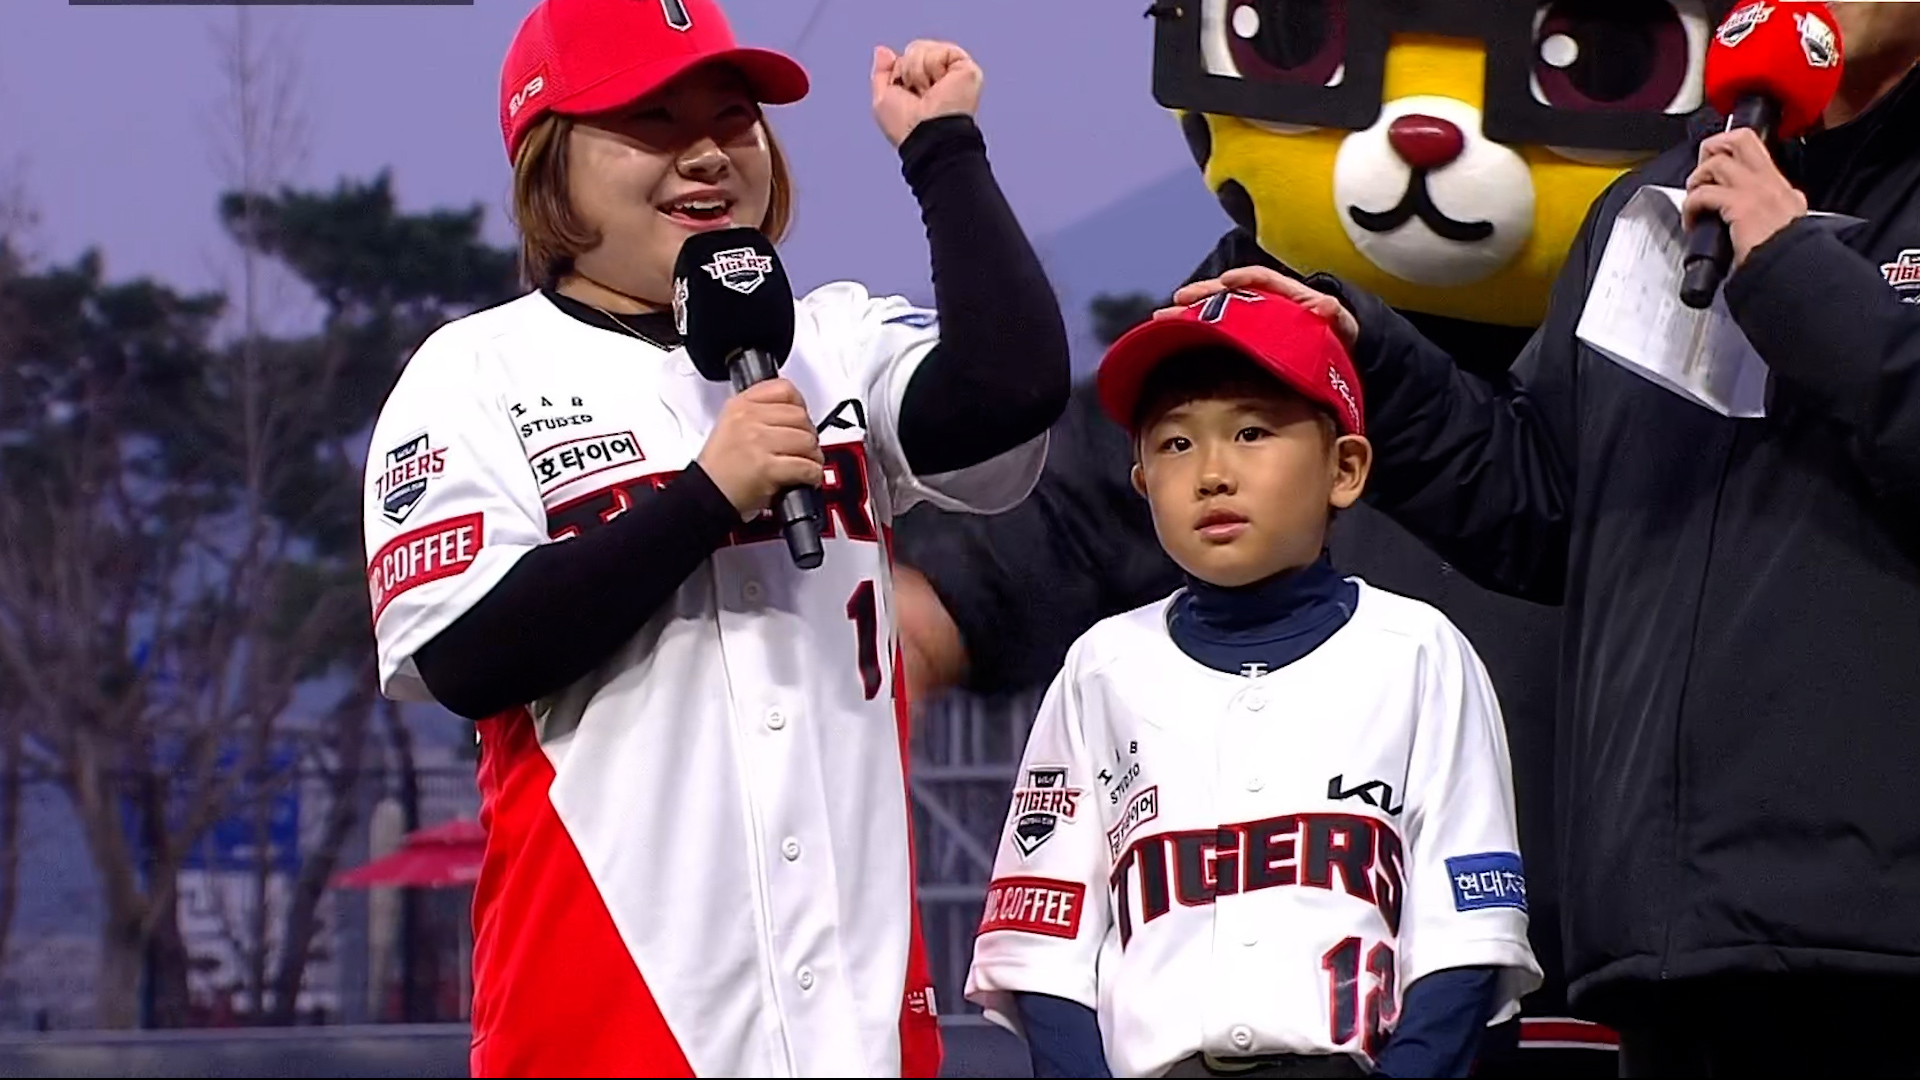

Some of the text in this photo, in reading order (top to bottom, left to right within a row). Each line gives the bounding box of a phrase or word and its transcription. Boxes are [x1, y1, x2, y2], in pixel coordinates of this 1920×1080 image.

[520, 414, 593, 438] STUDIO
[375, 446, 449, 502] TIGERS
[531, 437, 637, 485] 호타이어
[382, 525, 474, 592] COFFEE
[1014, 790, 1081, 818] TIGERS
[1000, 886, 1076, 927] COFFEE
[1110, 813, 1403, 954] TIGERS
[1322, 936, 1398, 1061] 12
